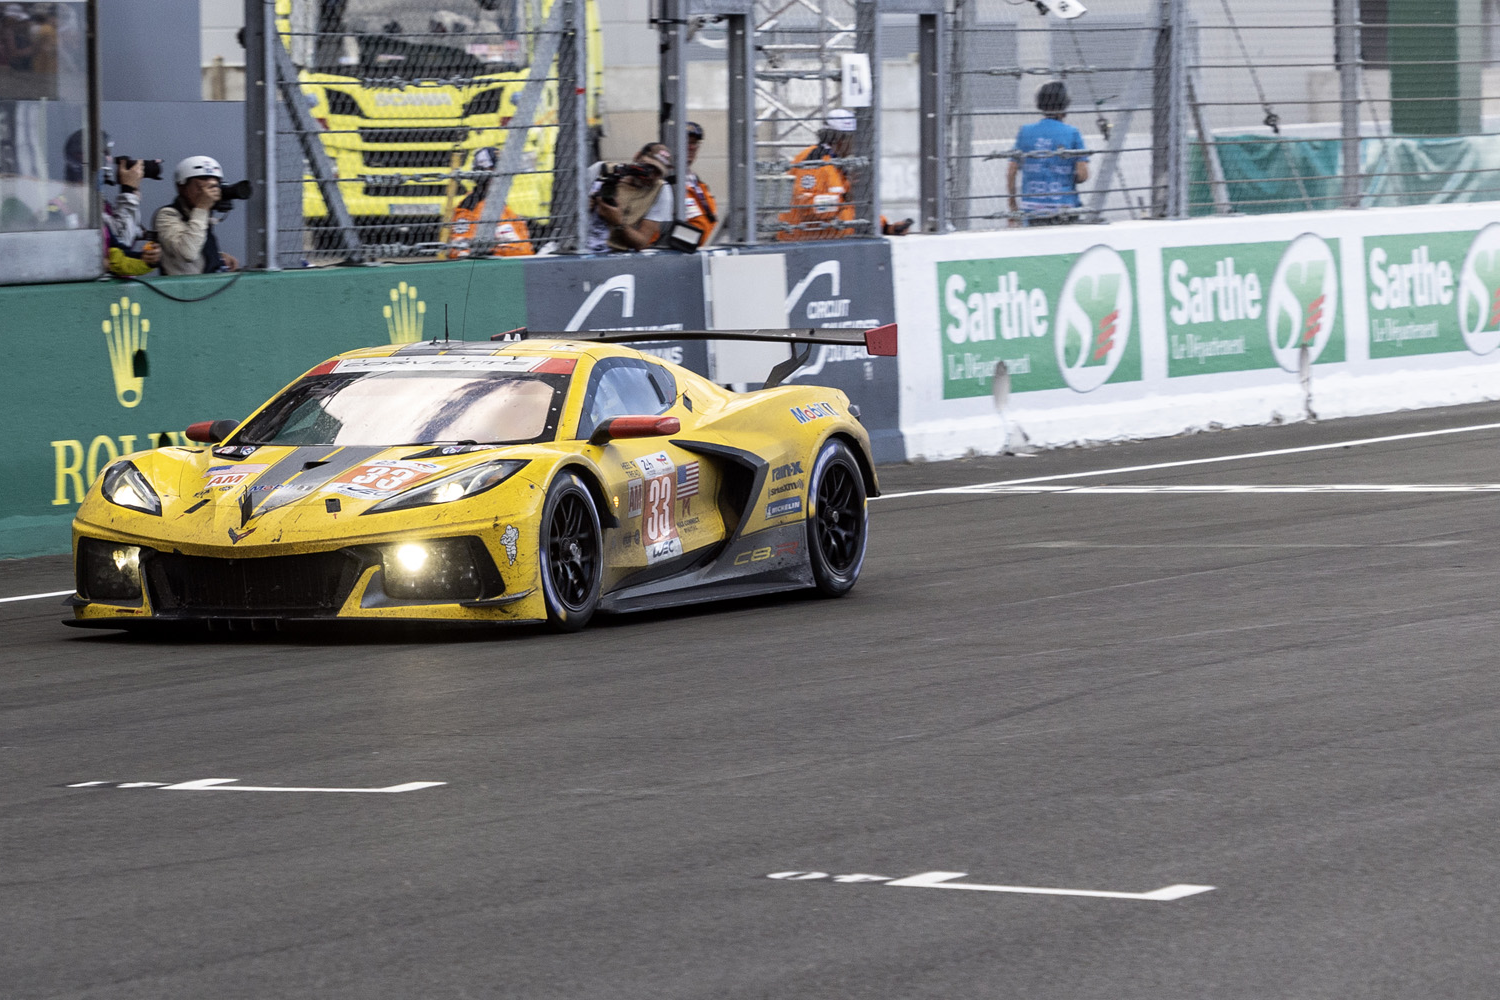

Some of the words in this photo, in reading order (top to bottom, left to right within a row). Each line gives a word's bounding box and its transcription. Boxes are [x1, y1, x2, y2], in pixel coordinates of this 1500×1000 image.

[1368, 245, 1454, 310] Sarthe
[1168, 257, 1262, 325] Sarthe
[945, 271, 1049, 344] Sarthe
[790, 403, 830, 424] Mobil
[208, 474, 244, 487] AM
[351, 466, 415, 490] 33
[647, 476, 671, 540] 33
[771, 501, 801, 513] MICHELIN
[652, 540, 675, 558] WEC
[734, 541, 799, 565] C8.R
